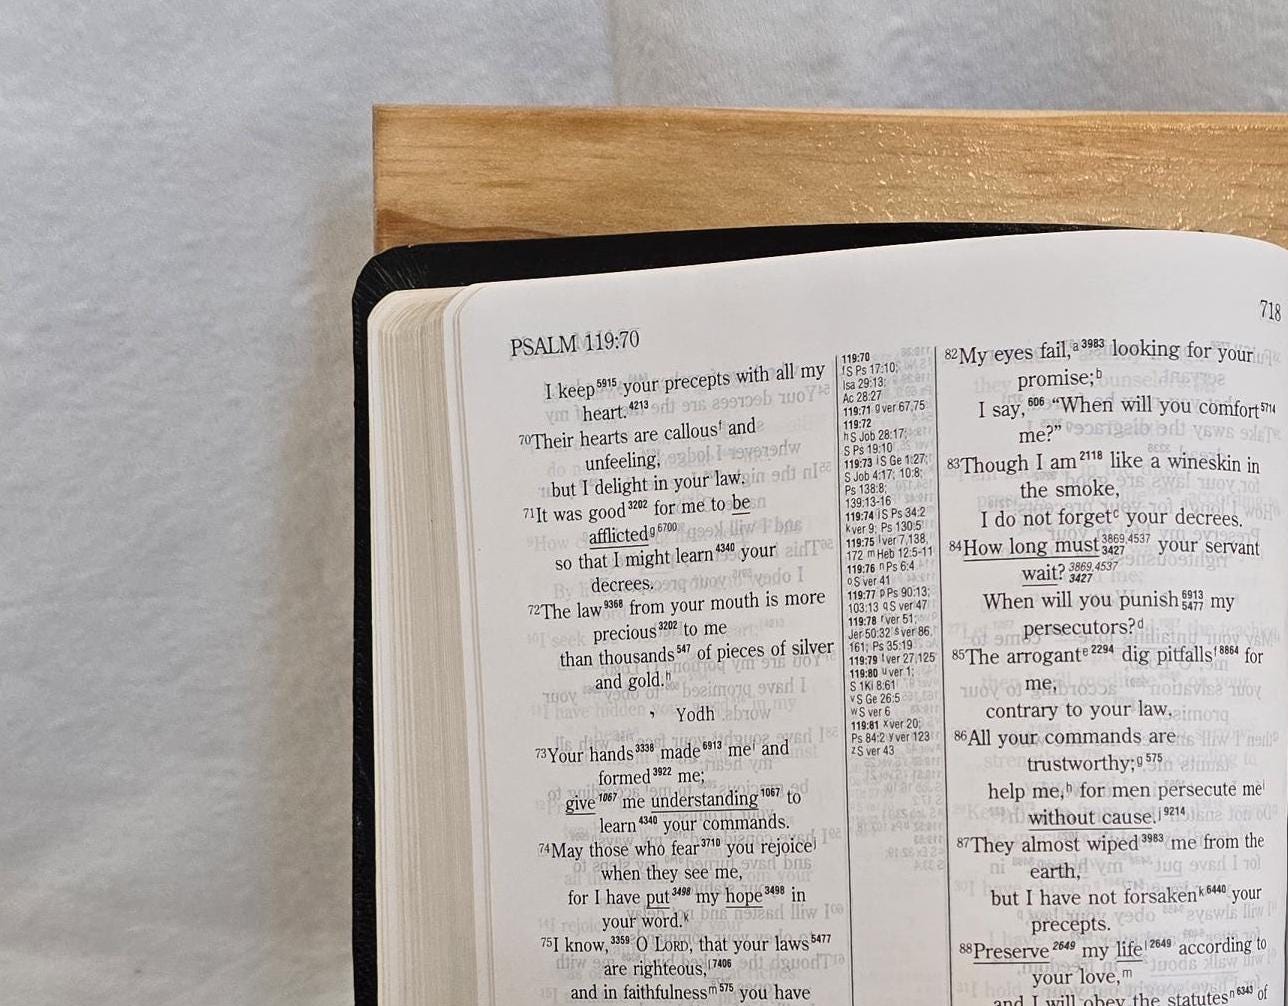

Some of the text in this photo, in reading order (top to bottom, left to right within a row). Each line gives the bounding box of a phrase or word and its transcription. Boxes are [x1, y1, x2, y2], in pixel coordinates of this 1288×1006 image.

[1259, 299, 1282, 322] 718
[510, 329, 640, 357] PSALM 119:70
[1111, 338, 1254, 364] looking for your
[842, 353, 870, 364] 119:70
[622, 362, 826, 398] your precepts with all my
[843, 391, 882, 404] Ac 28:27
[1051, 394, 1192, 417] “When will you
[844, 419, 872, 430] 119:72
[585, 451, 661, 472] unfeeling,
[1109, 450, 1260, 475] like a wineskin in
[551, 469, 746, 498] but I delight in your law.
[1019, 478, 1120, 500] the smoke,
[845, 495, 892, 508] 139:13-16
[591, 576, 654, 594] decrees.
[696, 637, 835, 663] of pieces of silver
[675, 705, 715, 723] Yodh
[985, 699, 1173, 722] contrary to your law.
[851, 720, 879, 730] 119:81
[600, 863, 743, 883] when they see me,
[990, 888, 1117, 907] but I have not
[1031, 916, 1111, 936] precepts.
